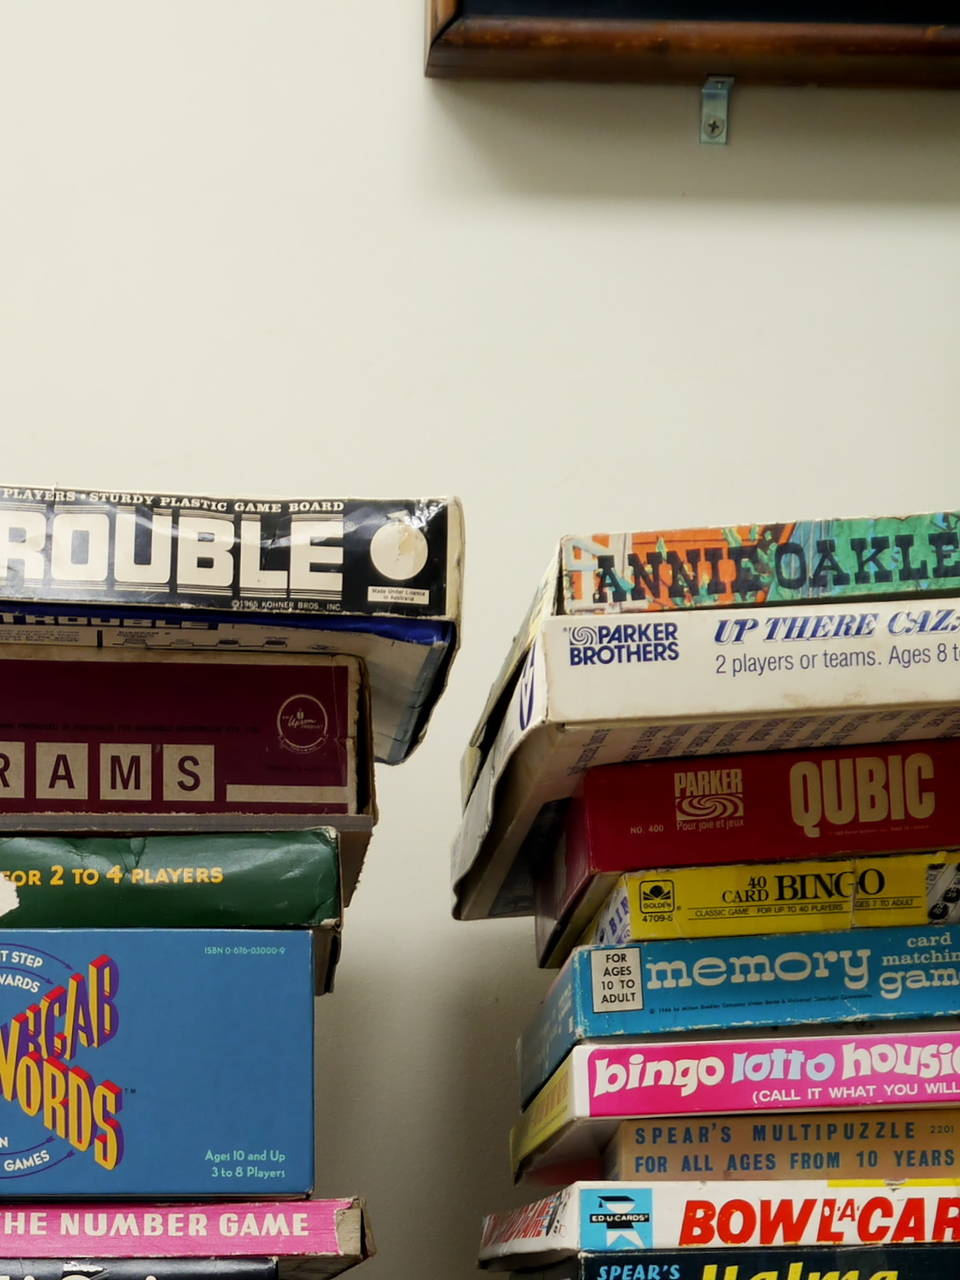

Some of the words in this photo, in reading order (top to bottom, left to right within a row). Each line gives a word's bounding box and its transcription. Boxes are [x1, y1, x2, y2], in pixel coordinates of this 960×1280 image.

[2, 489, 76, 501] PLAYERS
[90, 492, 154, 505] STURDY
[160, 496, 227, 511] PLASTIC
[288, 501, 344, 511] BOARD
[595, 545, 767, 603] ANNIE
[598, 622, 678, 642] PARKER
[714, 618, 759, 644] UP
[765, 613, 879, 640] THERE
[570, 641, 679, 666] BROTHERS
[732, 652, 794, 677] players
[823, 650, 882, 668] teams.
[674, 768, 743, 796] PARKER
[790, 752, 936, 838] QUBIC
[131, 866, 224, 884] PLAYERS
[722, 889, 769, 904] CARD
[775, 867, 886, 901] BINGO
[907, 932, 952, 948] card
[646, 949, 871, 990] memory
[601, 992, 636, 1004] ADULT
[593, 1054, 725, 1097] bingo
[731, 1048, 835, 1084] lotto
[884, 1085, 918, 1097] YOU
[635, 1124, 732, 1144] SPEAR'S
[753, 1122, 915, 1142] MULTIPUZZLE
[4, 1150, 50, 1172] GAMES
[205, 1150, 230, 1163] Ages
[790, 1151, 841, 1169] FROM
[895, 1149, 954, 1166] YEARS
[247, 1167, 285, 1179] Players
[60, 1213, 208, 1237] NUMBER
[219, 1213, 309, 1237] GAME
